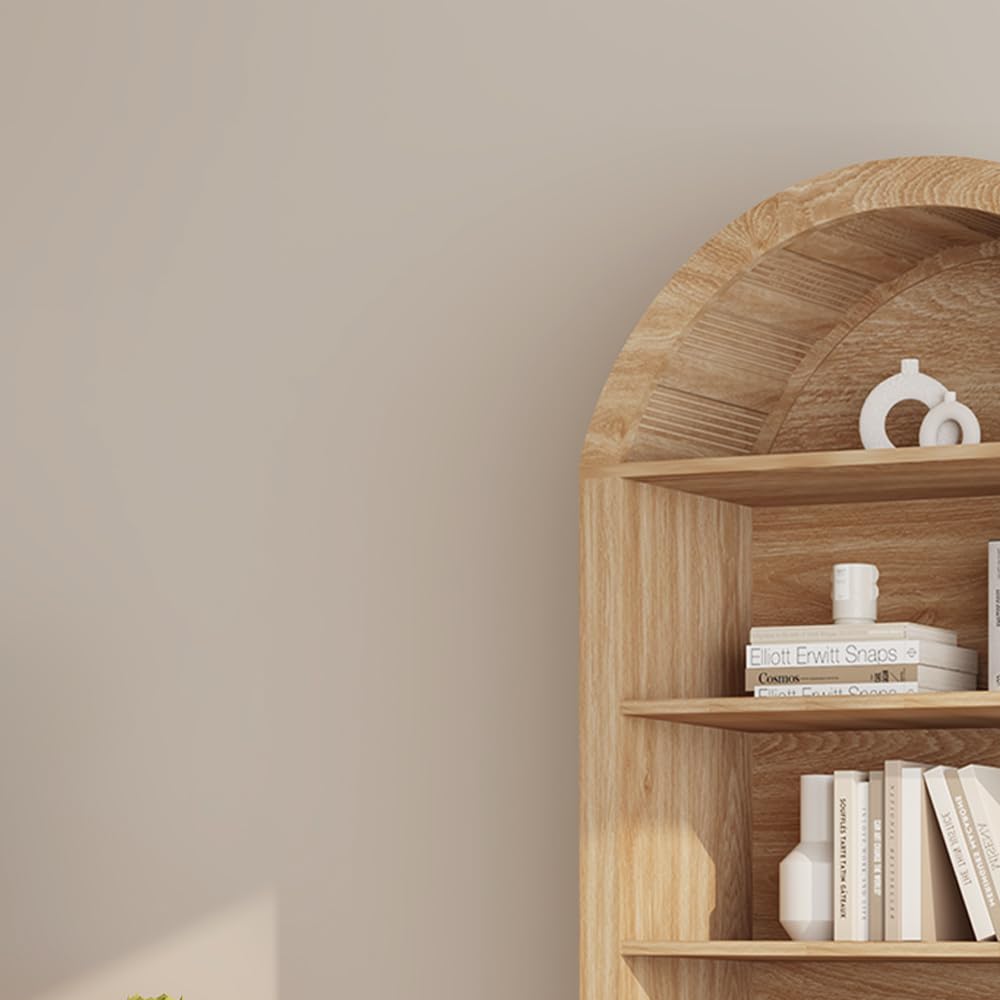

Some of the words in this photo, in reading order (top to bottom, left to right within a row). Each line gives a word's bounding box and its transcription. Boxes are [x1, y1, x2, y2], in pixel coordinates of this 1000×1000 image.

[750, 647, 791, 666] Elliott
[796, 645, 840, 665] Erwitt
[845, 644, 898, 663] Snaps
